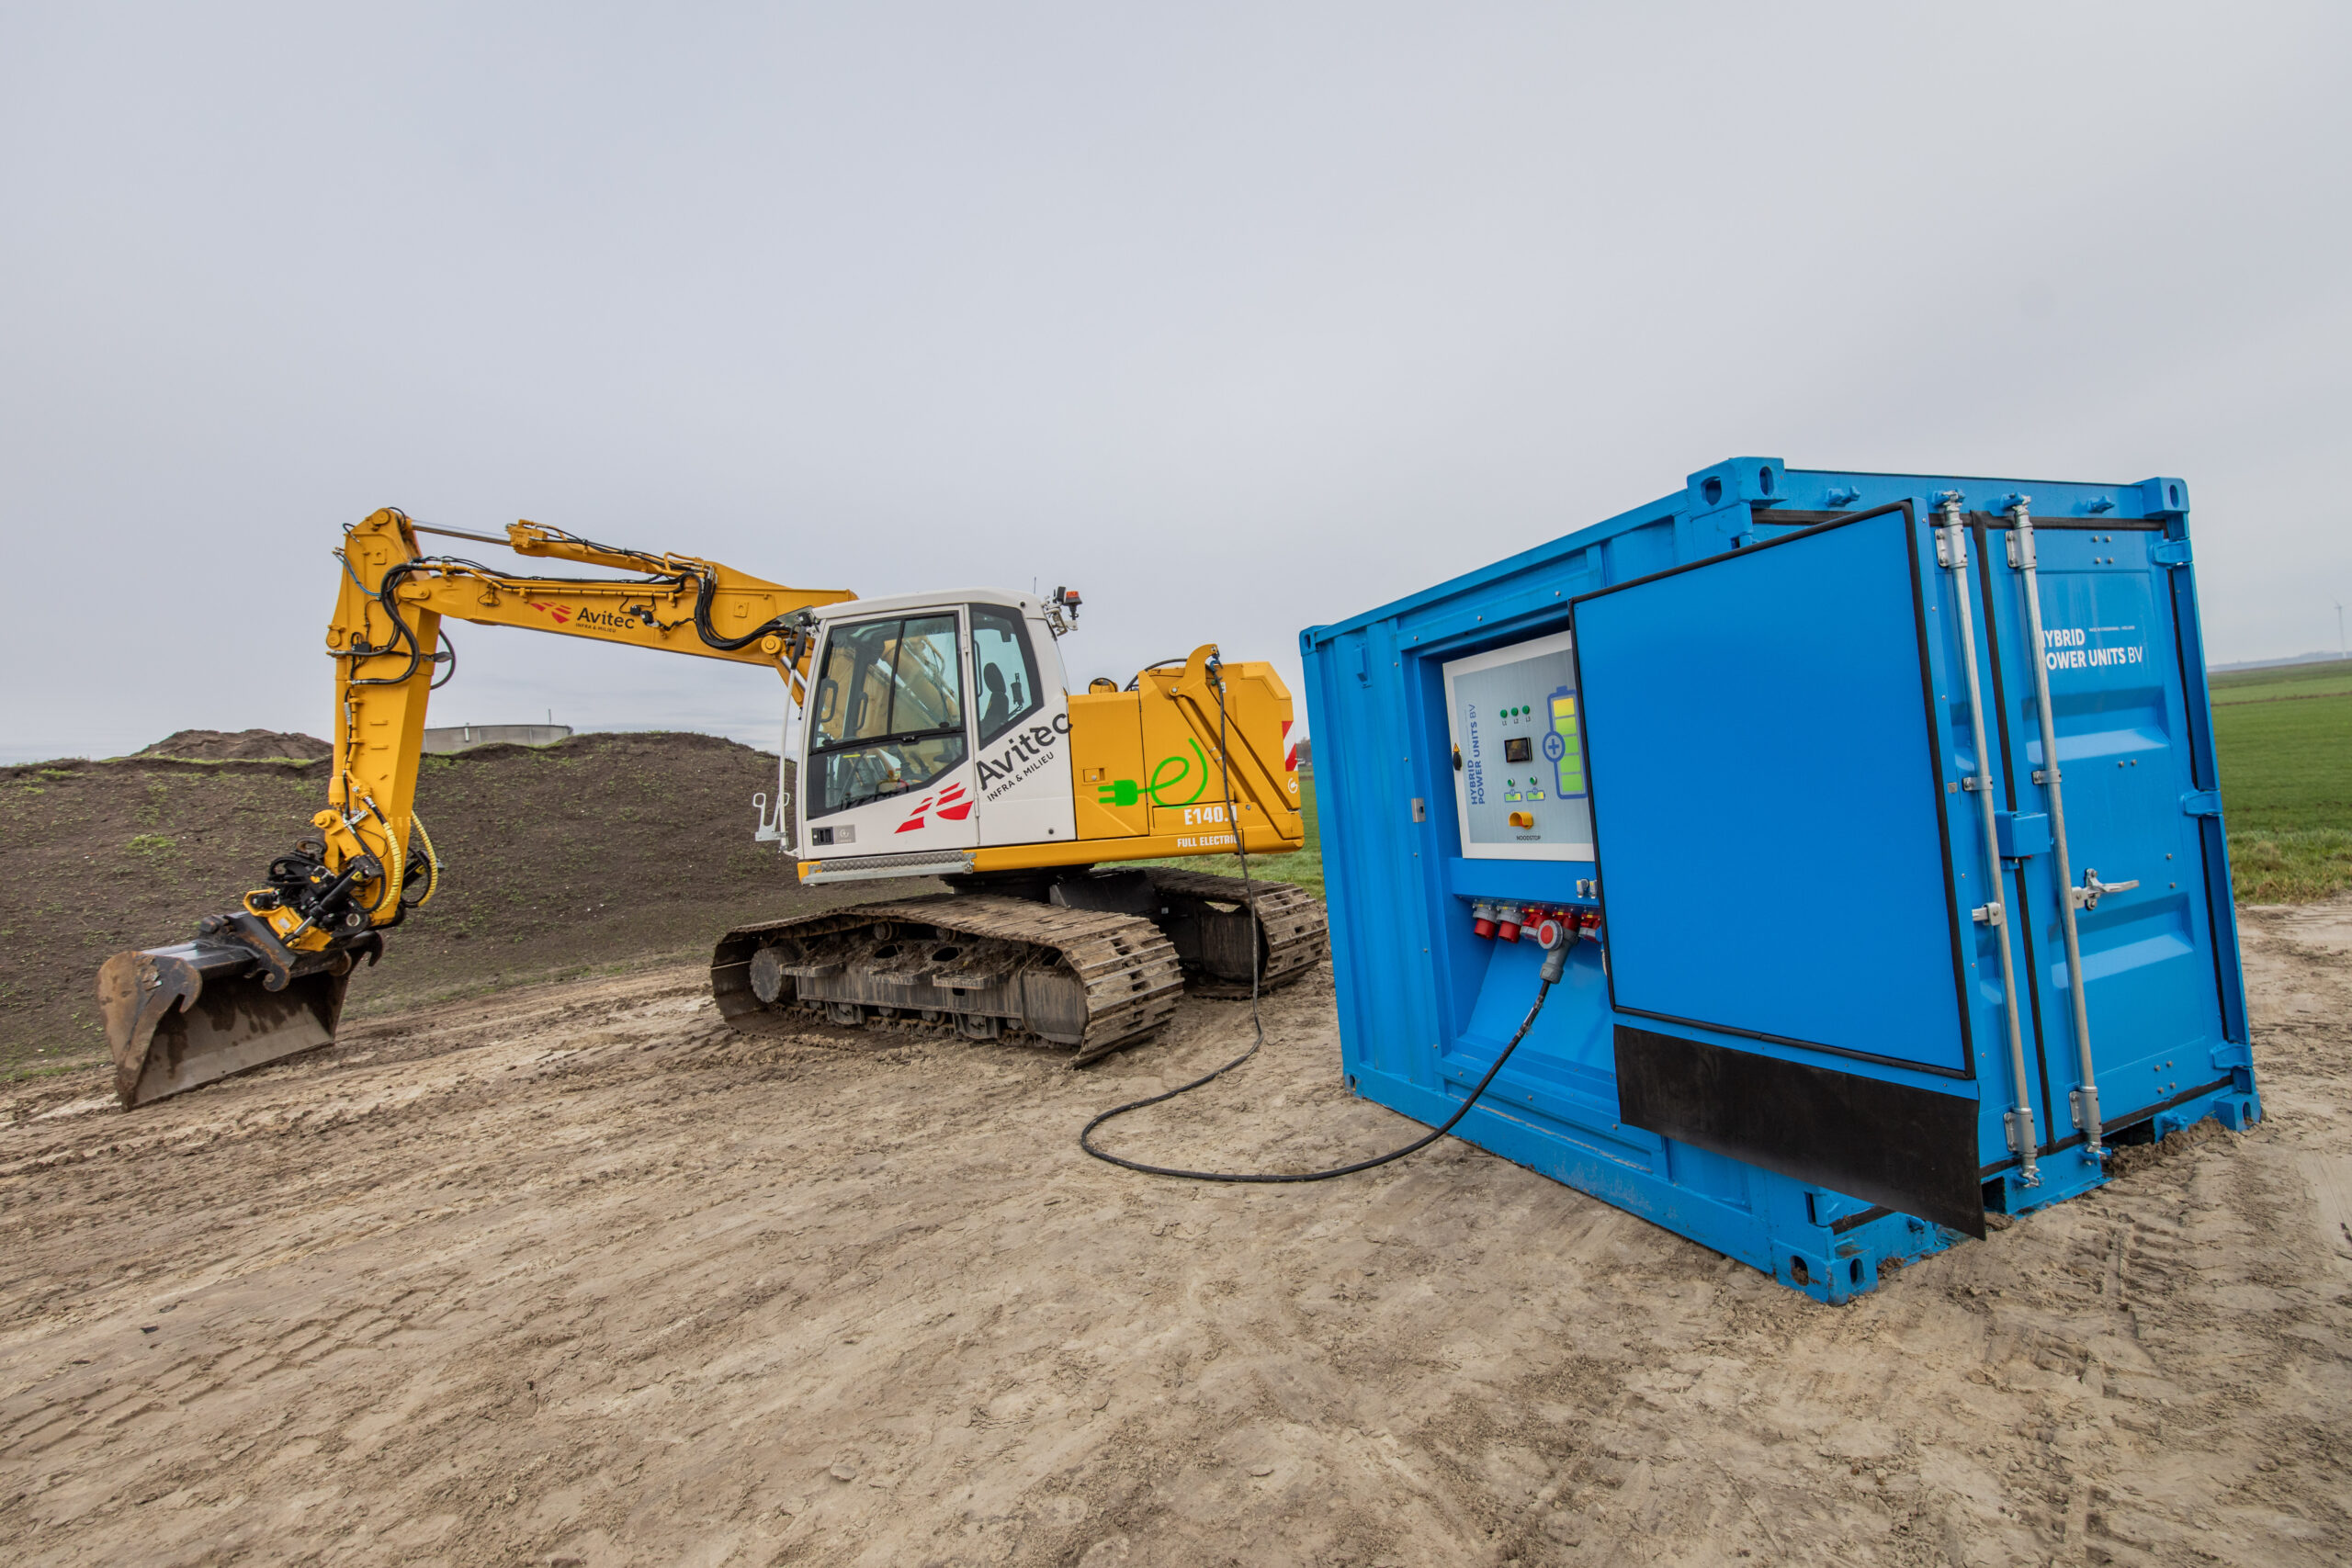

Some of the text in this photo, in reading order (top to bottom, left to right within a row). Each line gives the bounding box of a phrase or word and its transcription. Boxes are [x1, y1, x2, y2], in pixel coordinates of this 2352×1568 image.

[577, 607, 635, 629] Avitec
[2041, 628, 2086, 649] YBRID
[2046, 646, 2143, 671] OWER UNITS BV
[976, 713, 1073, 792] Avitec
[1468, 704, 1485, 805] POWER UNITS BV
[987, 751, 1055, 802] INFRA & MILIEU
[1467, 760, 1478, 806] HYBRID
[1177, 837, 1198, 848] FULL
